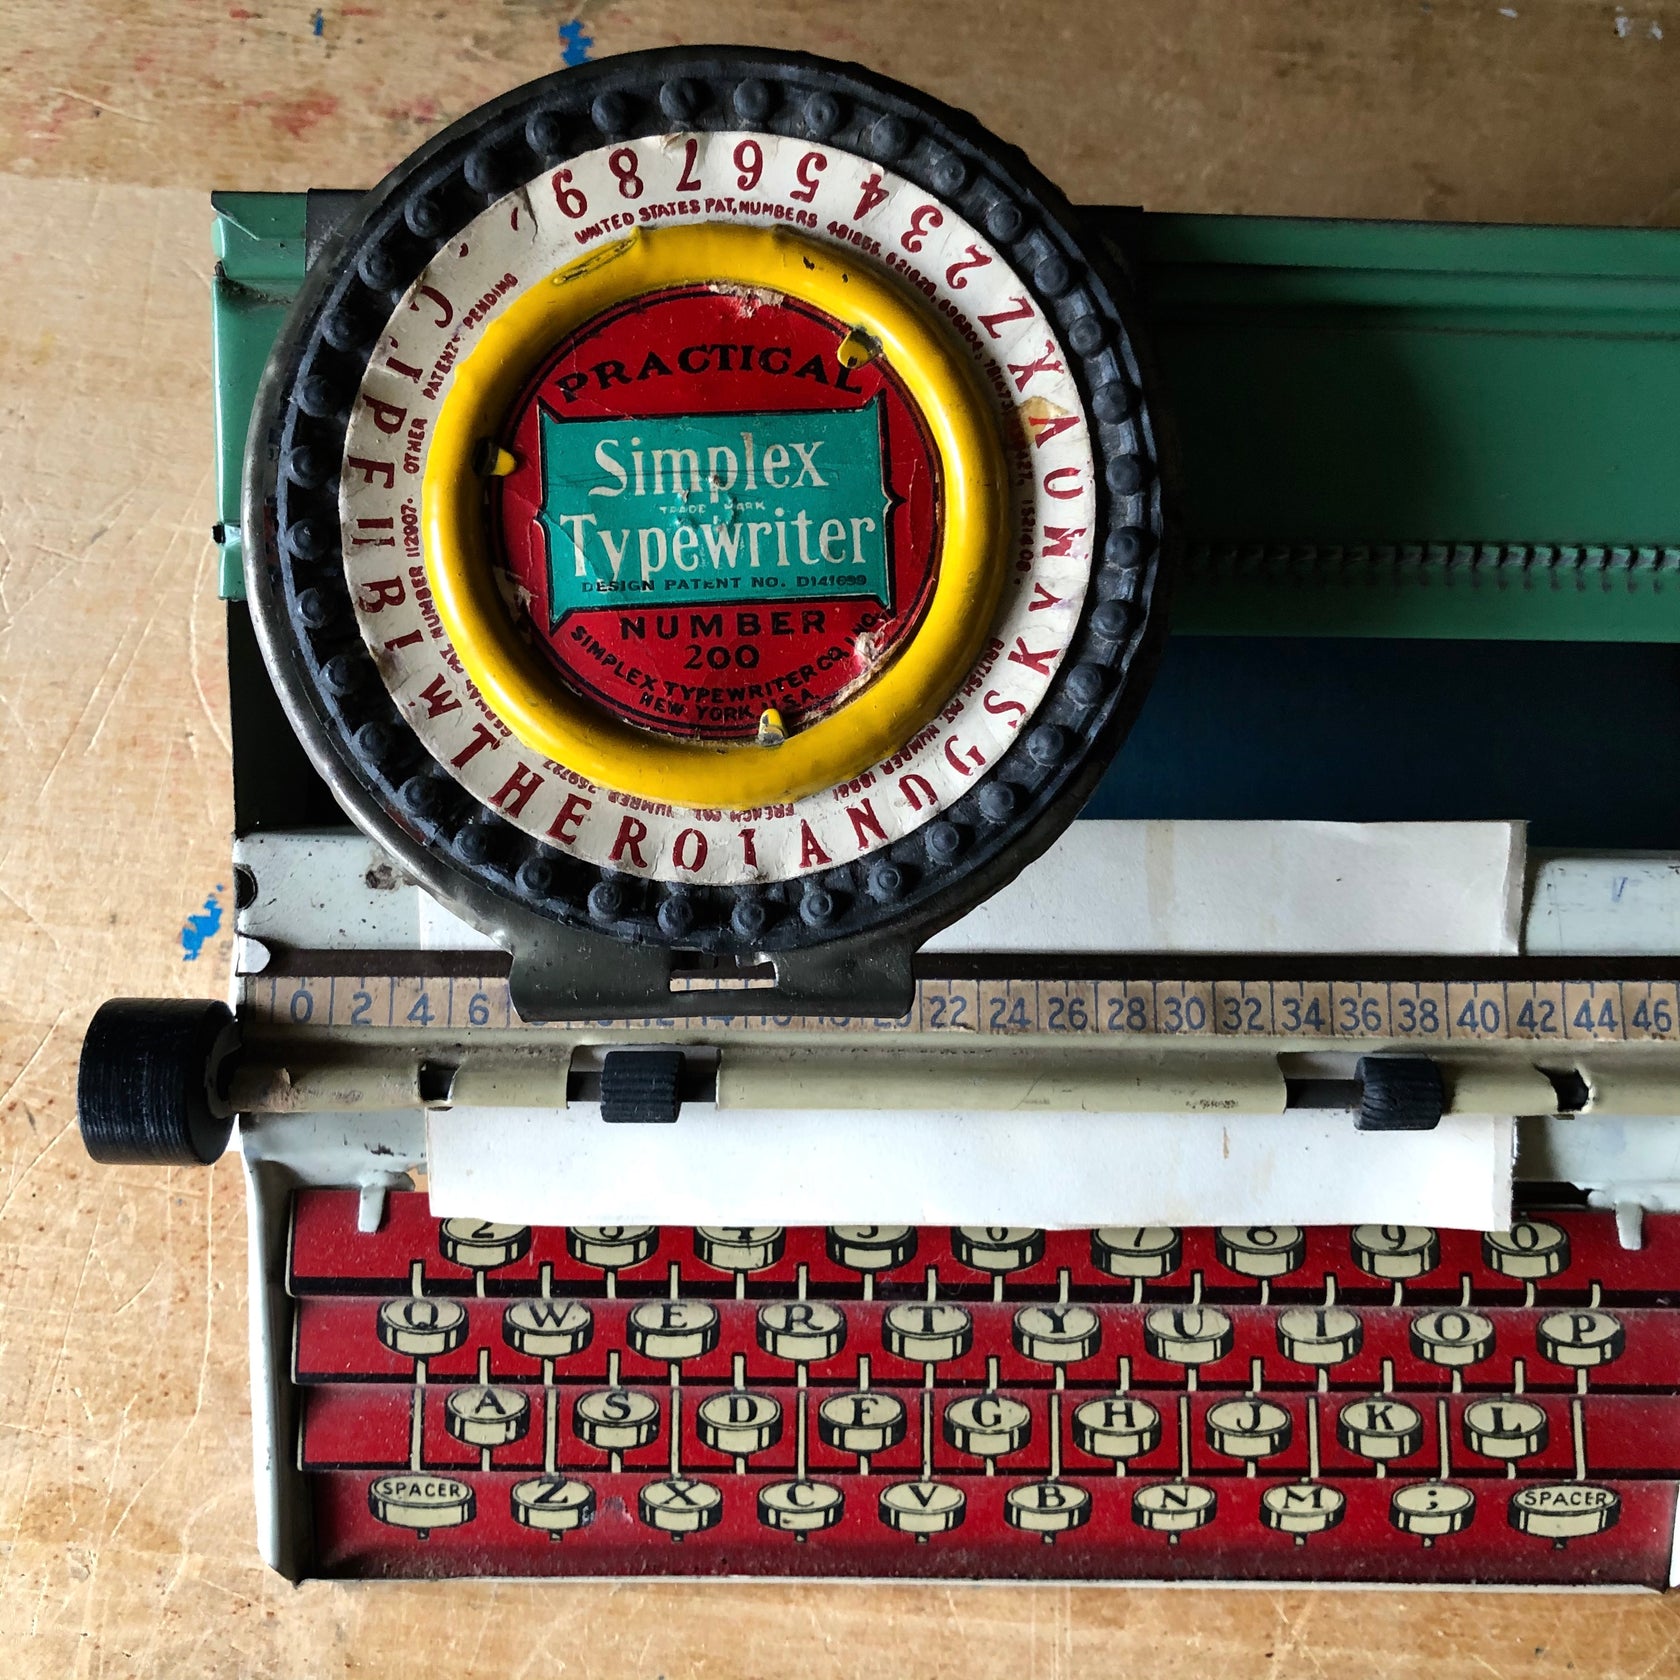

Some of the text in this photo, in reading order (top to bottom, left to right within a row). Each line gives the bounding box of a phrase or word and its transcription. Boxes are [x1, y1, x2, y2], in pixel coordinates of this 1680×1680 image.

[608, 148, 644, 199] 8
[676, 139, 702, 191] 7
[790, 152, 828, 203] 5
[551, 169, 588, 219] 9
[854, 173, 890, 221] 4
[573, 209, 634, 244] UNITED
[638, 199, 700, 222] STATES
[900, 204, 944, 253] 3
[945, 244, 993, 289] 2
[978, 296, 1035, 339] Z
[402, 417, 428, 474] OTHER
[461, 271, 519, 331] PENDING
[553, 343, 864, 404] PRACTICAL
[1008, 340, 1065, 392] X
[362, 393, 408, 434] P
[346, 453, 396, 490] F
[588, 432, 830, 504] Simplex
[659, 503, 706, 514] TRADE
[559, 508, 877, 593] Typewriter
[358, 576, 406, 613] B
[581, 579, 655, 593] DESIGN
[664, 577, 742, 591] PATENT
[751, 576, 786, 589] NO.
[408, 566, 445, 641] NUMBER
[620, 609, 826, 640] NUMBER
[570, 625, 659, 692] SIMPLEX
[664, 665, 818, 704] TYPEWRITER
[683, 643, 760, 670] 200
[959, 637, 1006, 698] BRITISH
[1007, 637, 1061, 677] K
[638, 691, 686, 717] NEW
[983, 689, 1027, 729] S
[450, 722, 501, 768] T
[880, 724, 941, 777] NUMBER
[944, 735, 986, 776] G
[487, 761, 545, 818] H
[546, 793, 592, 844] E
[846, 797, 889, 851] N
[608, 815, 648, 868] R
[738, 828, 758, 869] I
[799, 818, 832, 869] A
[290, 990, 491, 1027] 0 2 4 6
[929, 995, 1673, 1034] 22 24 26 28 30 32 34 36 38 40 42 44 46
[1380, 1224, 1406, 1250] 9
[403, 1303, 438, 1329] Q
[528, 1302, 570, 1328] W
[661, 1303, 688, 1329] E
[783, 1304, 824, 1333] R
[907, 1306, 945, 1332] T
[1171, 1309, 1205, 1339] U
[1434, 1312, 1470, 1342] O
[1569, 1314, 1597, 1342] P
[475, 1389, 507, 1415] A
[602, 1392, 632, 1420] S
[729, 1399, 758, 1423] D
[850, 1397, 879, 1425] F
[971, 1399, 1002, 1428] G
[1102, 1402, 1135, 1428] H
[1236, 1404, 1261, 1432] J
[1365, 1404, 1395, 1431] K
[1490, 1406, 1521, 1436] L
[381, 1481, 461, 1498] SPACER
[533, 1480, 569, 1504] Z
[661, 1482, 695, 1505] X
[787, 1481, 815, 1508] C
[908, 1485, 939, 1508] V
[1036, 1485, 1067, 1508] B
[1160, 1488, 1190, 1509] N
[1283, 1488, 1323, 1509] M
[1523, 1490, 1608, 1508] SPACER
